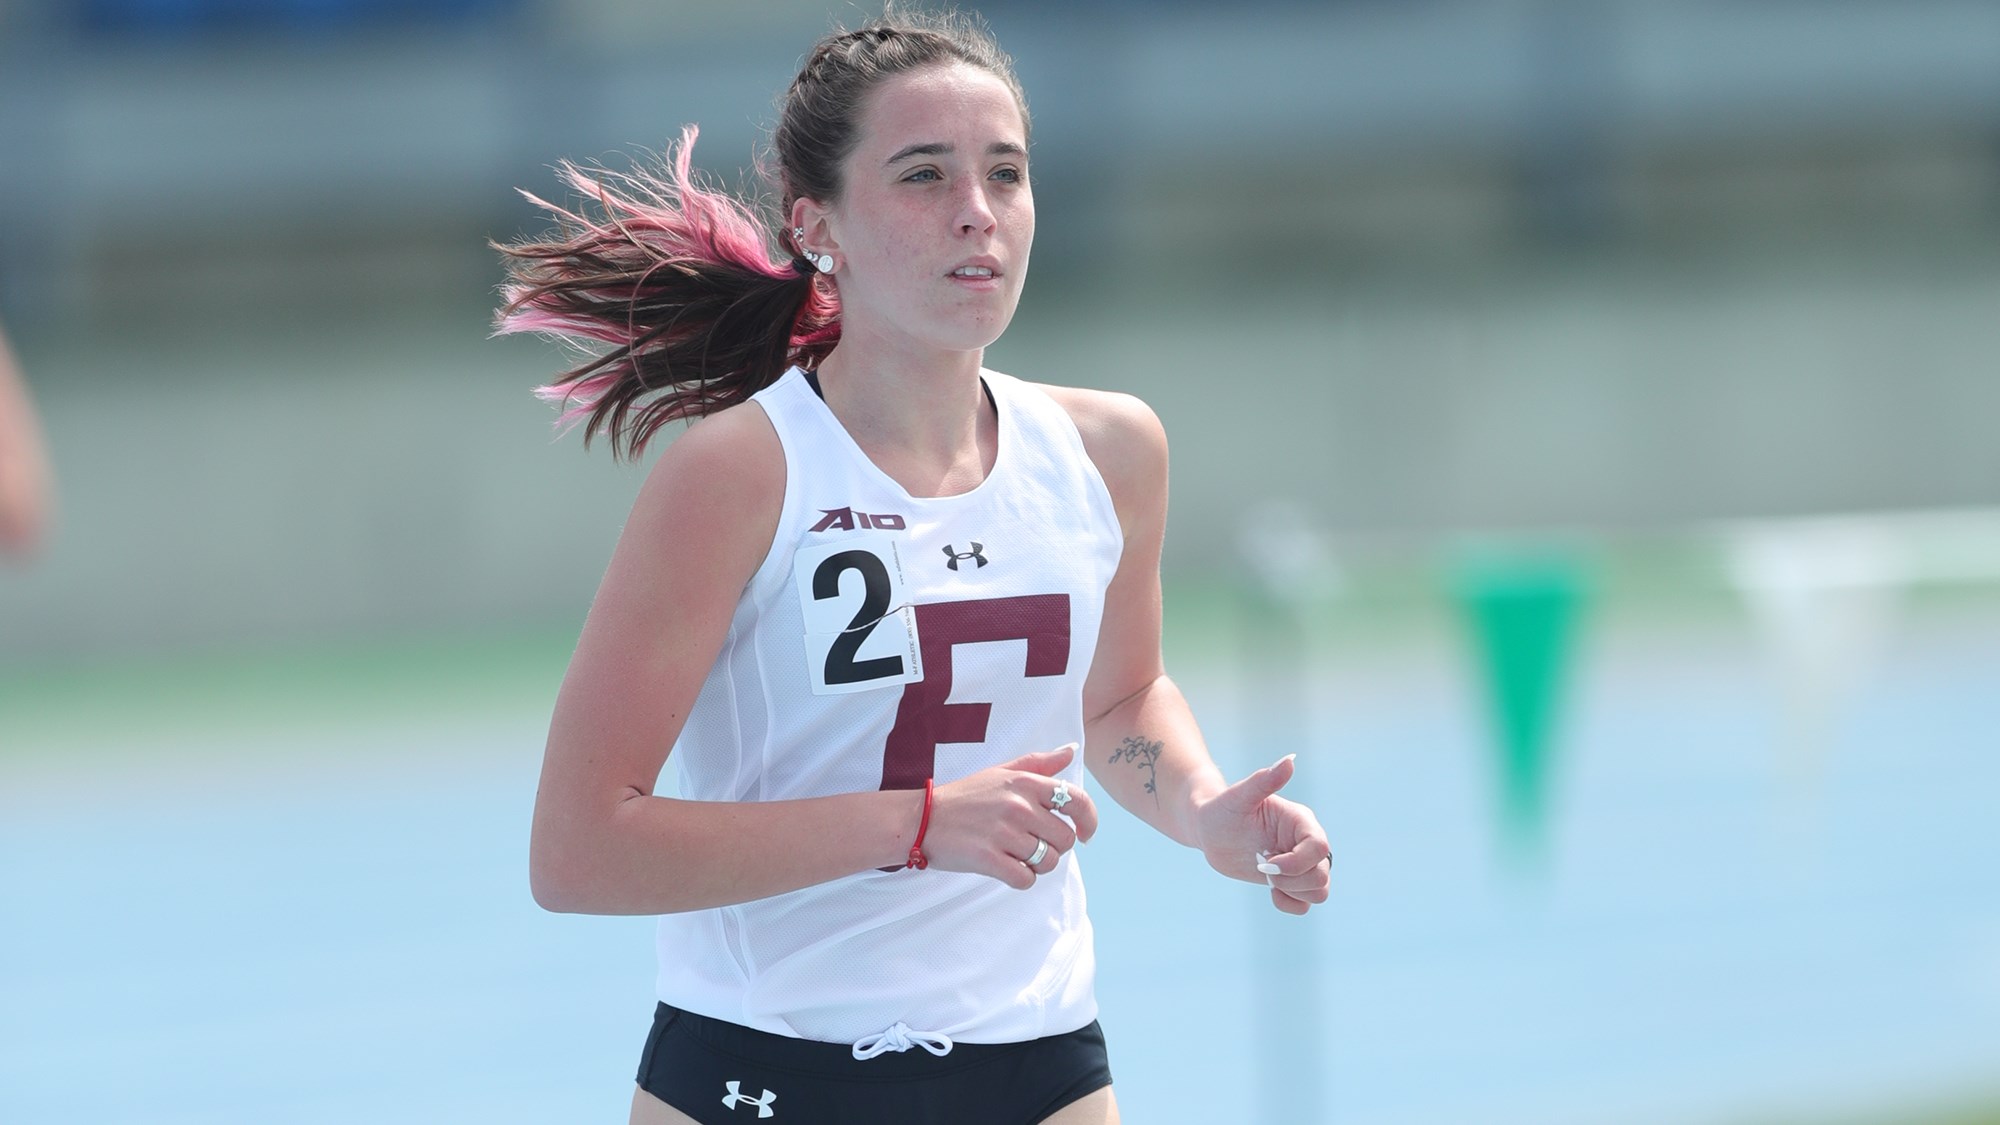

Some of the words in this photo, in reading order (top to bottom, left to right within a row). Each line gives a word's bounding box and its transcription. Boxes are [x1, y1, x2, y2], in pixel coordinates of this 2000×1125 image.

[808, 506, 906, 532] A10
[812, 549, 904, 685] 2
[909, 641, 918, 665] ATHLETIC
[875, 593, 1071, 871] F
